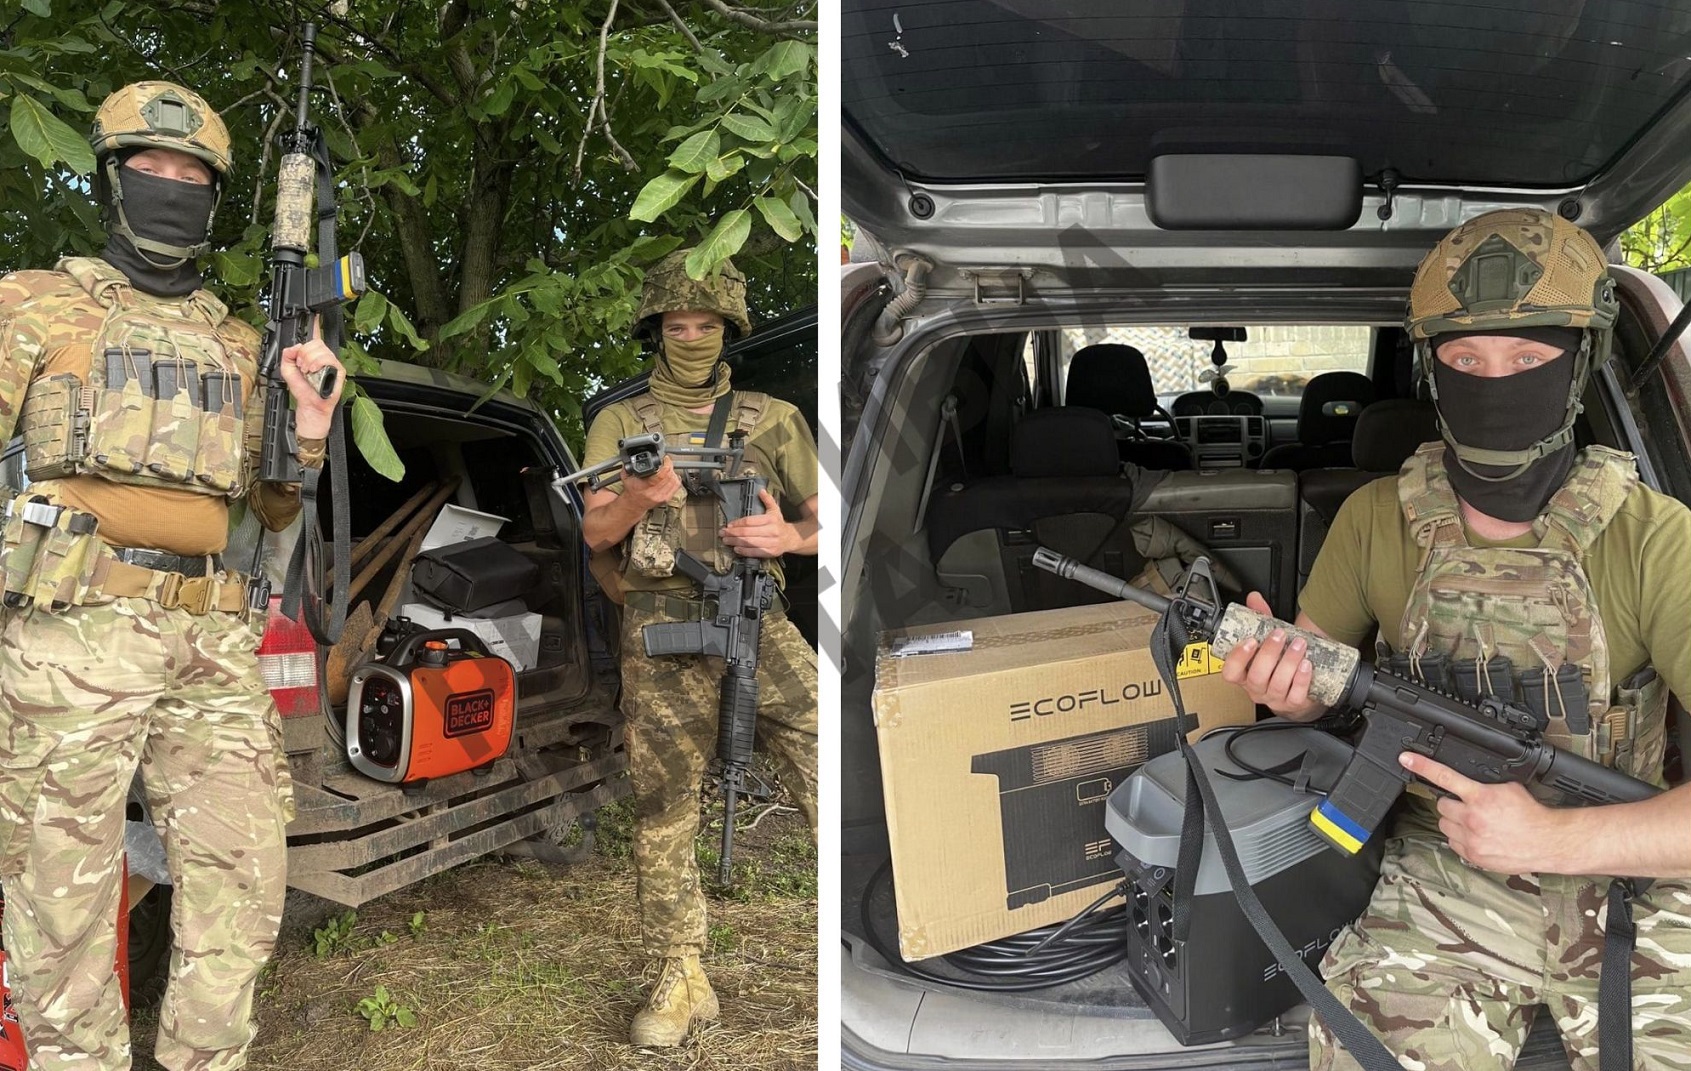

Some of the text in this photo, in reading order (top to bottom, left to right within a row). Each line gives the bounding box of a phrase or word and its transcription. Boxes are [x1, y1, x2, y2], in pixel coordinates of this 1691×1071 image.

[451, 700, 489, 716] BLACK+
[1010, 679, 1161, 721] ECOFLOW
[450, 711, 489, 728] DECKER
[1264, 919, 1356, 981] EFLO
